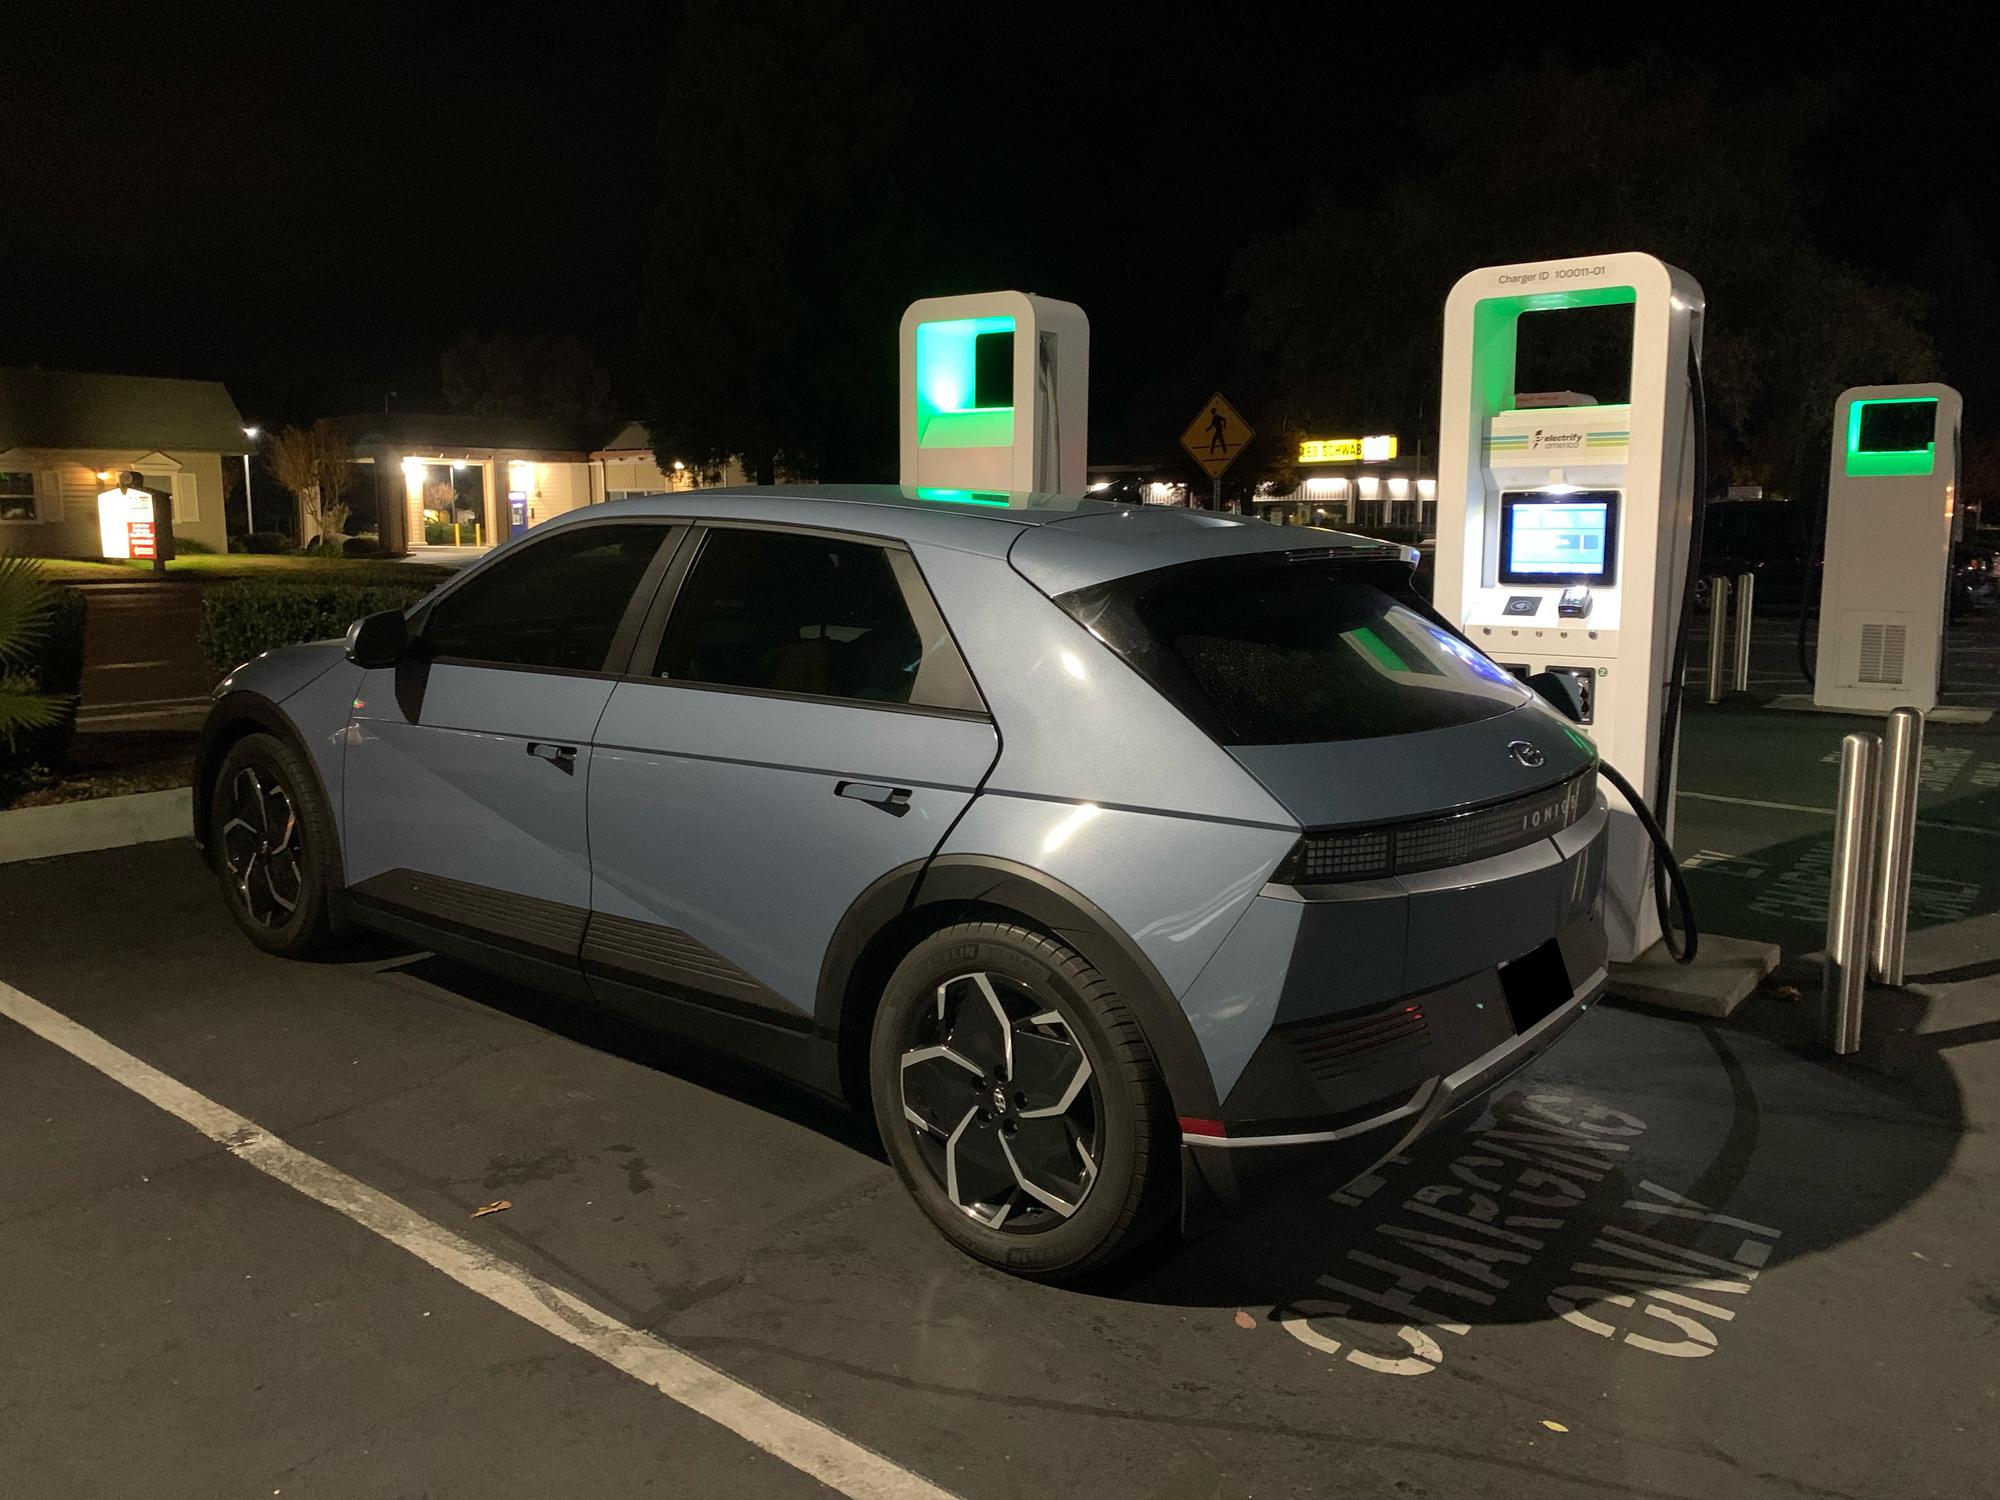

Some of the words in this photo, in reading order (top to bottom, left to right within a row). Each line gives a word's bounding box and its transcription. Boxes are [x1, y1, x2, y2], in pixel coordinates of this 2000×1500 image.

[1499, 272, 1537, 284] Charger
[1539, 271, 1549, 280] ID
[1555, 267, 1605, 279] 100011-01
[1323, 443, 1362, 456] SCHWAB
[1544, 433, 1582, 442] electrify
[1523, 799, 1568, 830] IONIQ
[1280, 1095, 1647, 1375] CHARGING
[1547, 1180, 1782, 1357] ONLY
